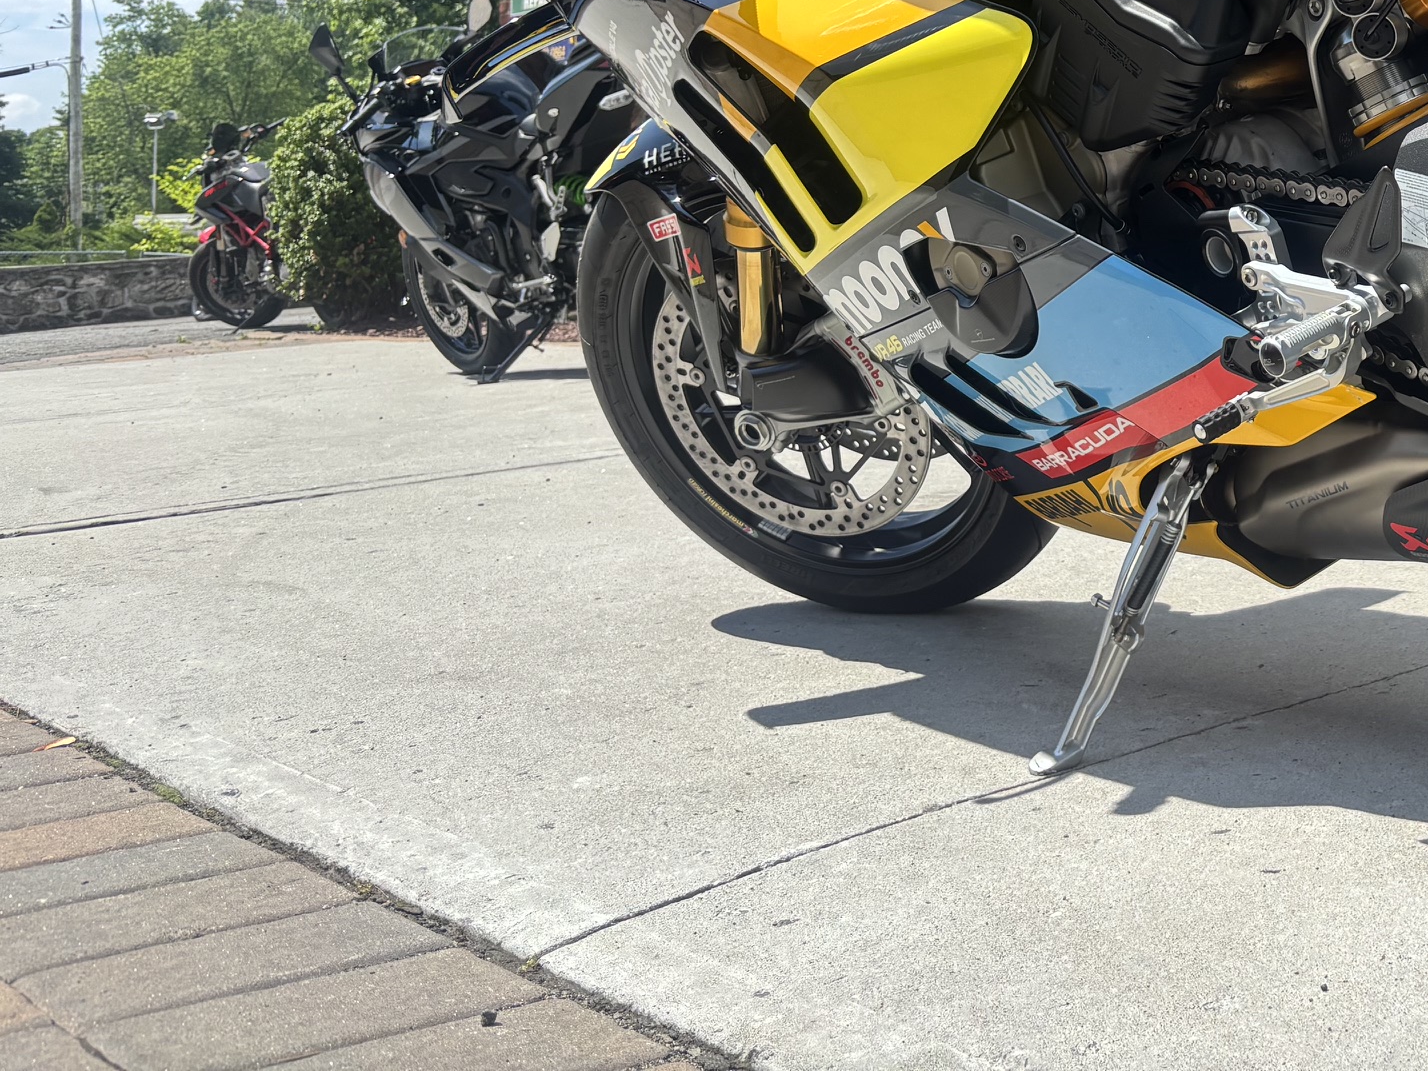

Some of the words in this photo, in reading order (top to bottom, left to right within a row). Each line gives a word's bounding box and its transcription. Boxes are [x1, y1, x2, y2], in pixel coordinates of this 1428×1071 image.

[902, 329, 926, 348] RACING
[844, 335, 884, 388] brembo
[1032, 416, 1135, 471] BARRACUDA
[1286, 481, 1349, 509] TITANIUM
